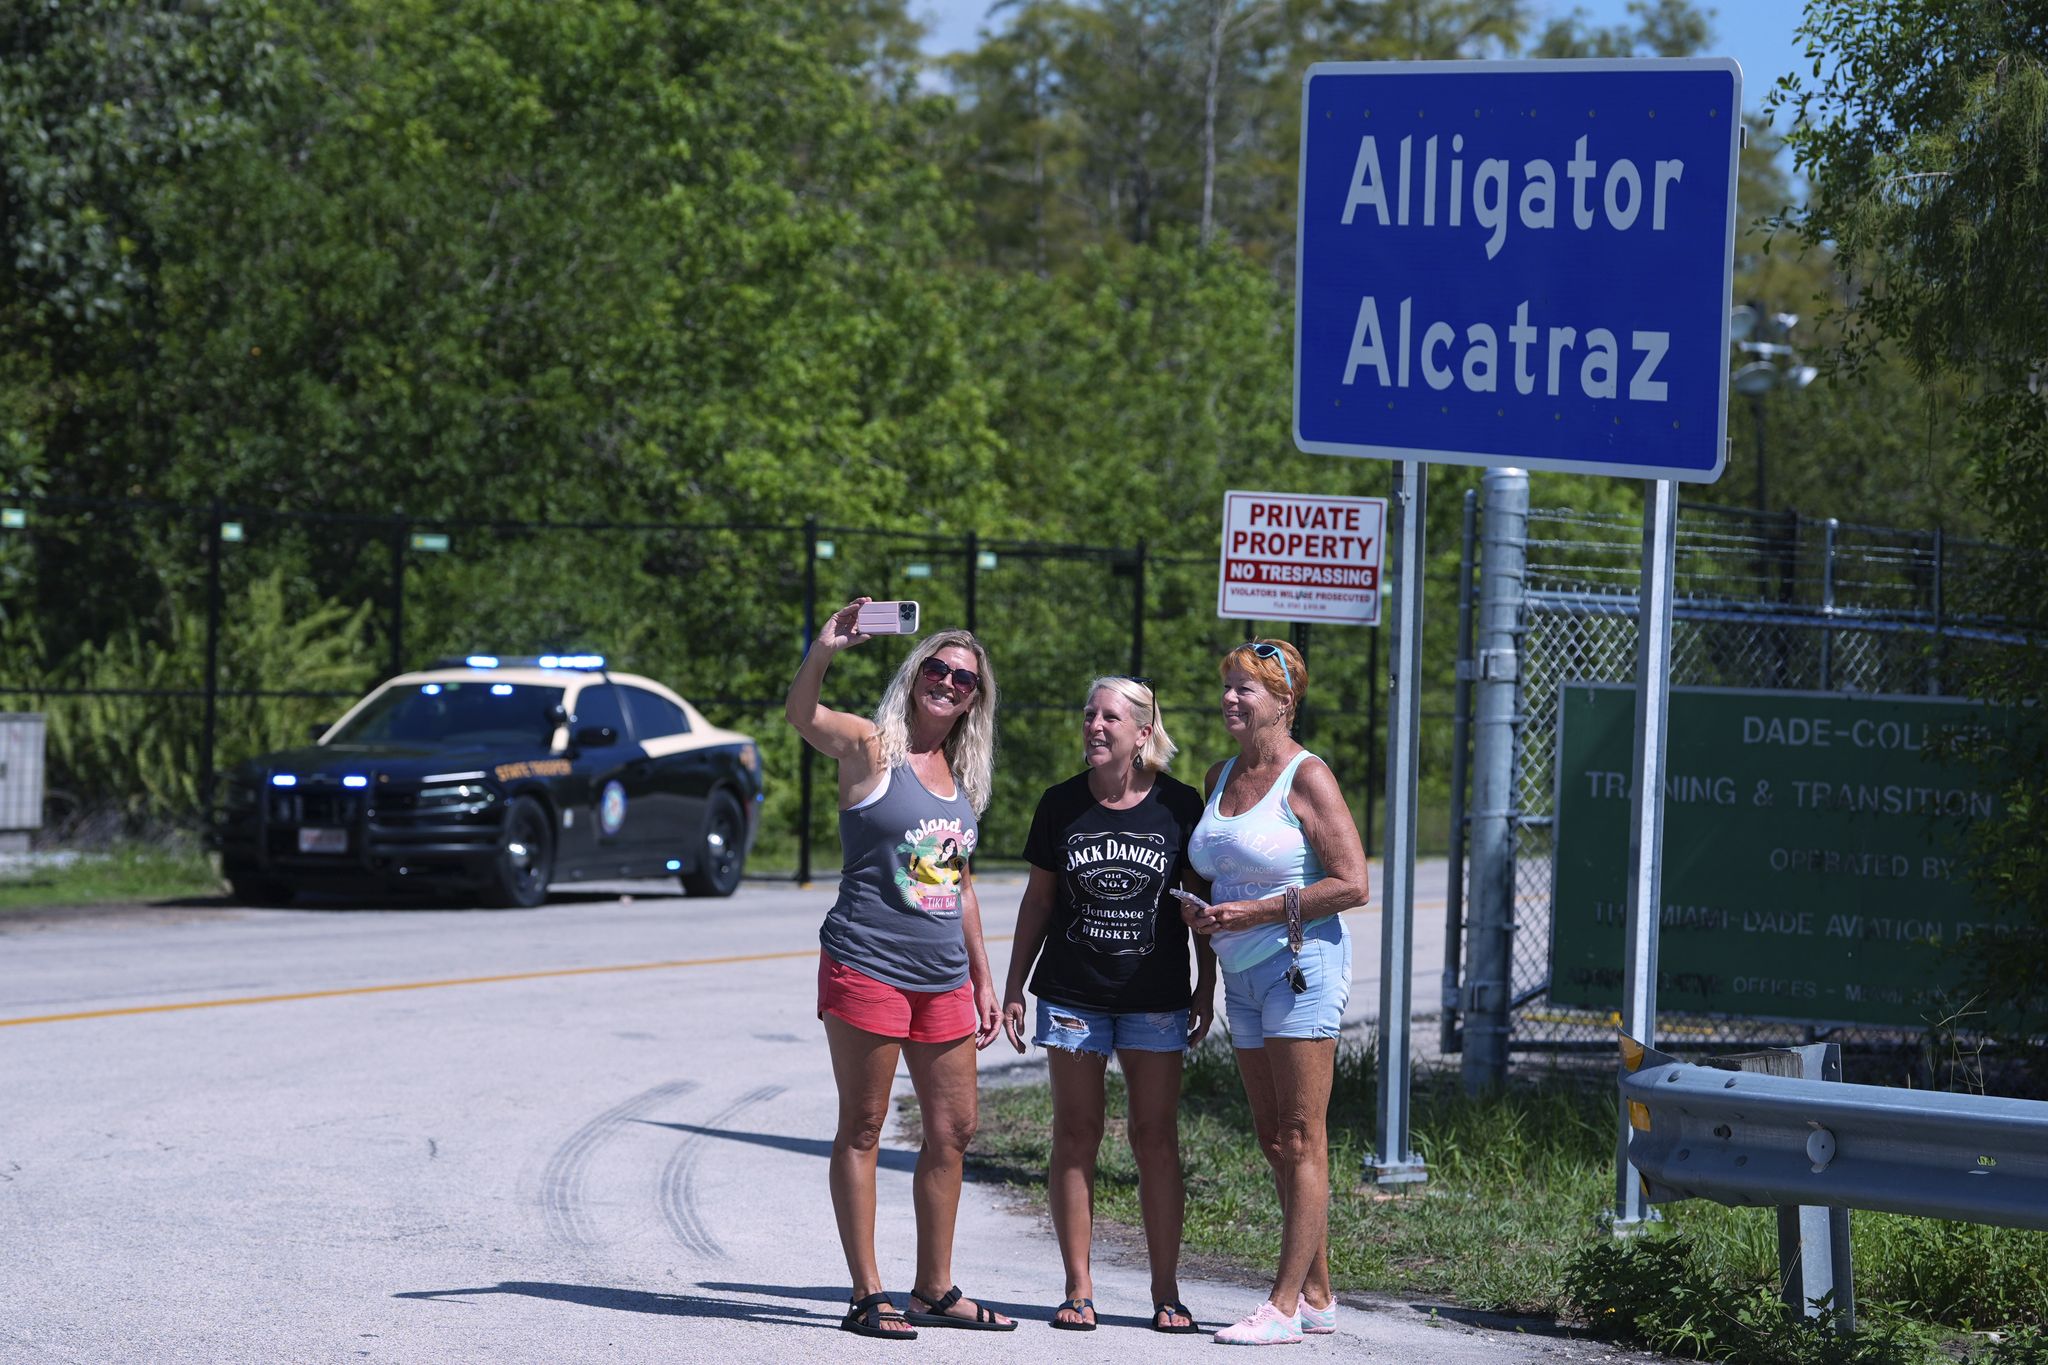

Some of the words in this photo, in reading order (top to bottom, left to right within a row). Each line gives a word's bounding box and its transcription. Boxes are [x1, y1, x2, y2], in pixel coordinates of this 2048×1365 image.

[1341, 133, 1685, 261] Alligator
[1341, 296, 1670, 402] Alcatraz
[1249, 503, 1361, 531] PRIVATE
[1232, 531, 1373, 560] PROPERTY
[1230, 563, 1256, 580] NO
[1260, 565, 1373, 586] TRESPASSING
[1230, 586, 1277, 598] VIOLATORS
[1315, 592, 1371, 603] PROSECUTED
[1585, 771, 1736, 806] TRNING
[1753, 779, 1774, 807] &
[1791, 781, 1993, 817] TRANSITION
[904, 817, 963, 846] Island
[1066, 844, 1104, 872] JACK
[1106, 838, 1169, 874] DANIEL'S
[1769, 847, 1909, 877] OPERATED
[1921, 856, 1955, 880] BY
[927, 897, 944, 909] TIKI
[1081, 903, 1144, 919] Tennessee
[1082, 924, 1141, 941] WHISKEY
[1825, 913, 1943, 942] AVIATION
